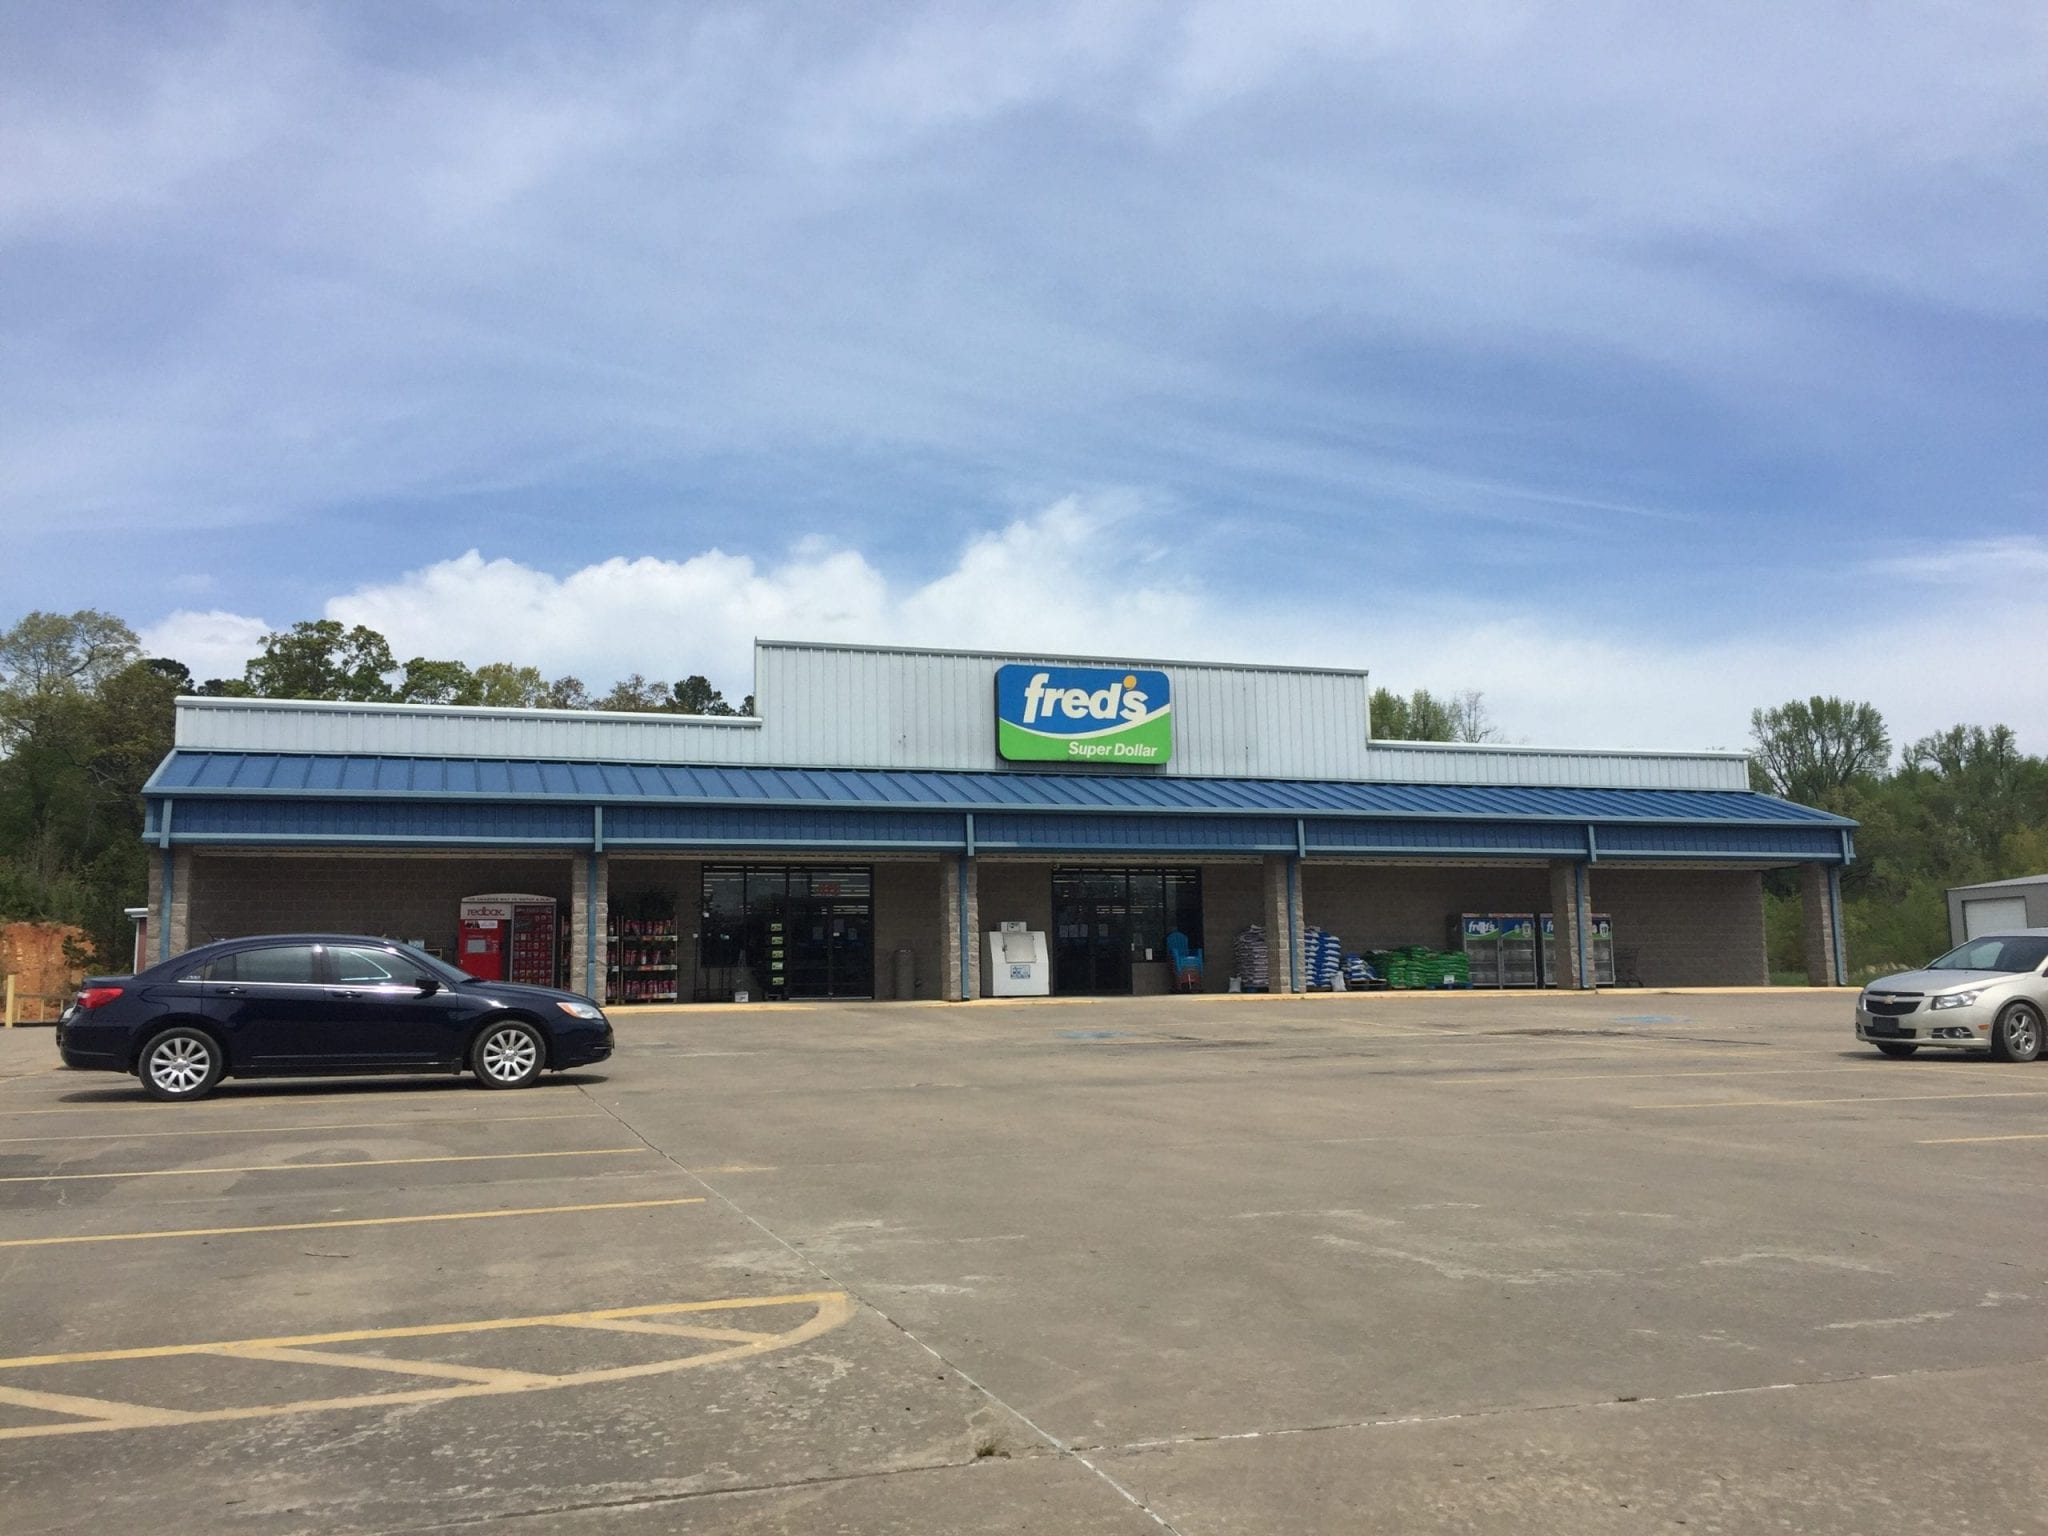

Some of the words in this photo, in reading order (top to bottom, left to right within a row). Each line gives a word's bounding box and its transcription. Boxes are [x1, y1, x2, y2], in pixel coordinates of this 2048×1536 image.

[1023, 673, 1149, 723] fred's
[1068, 742, 1113, 758] Super
[1114, 743, 1158, 757] Dollar
